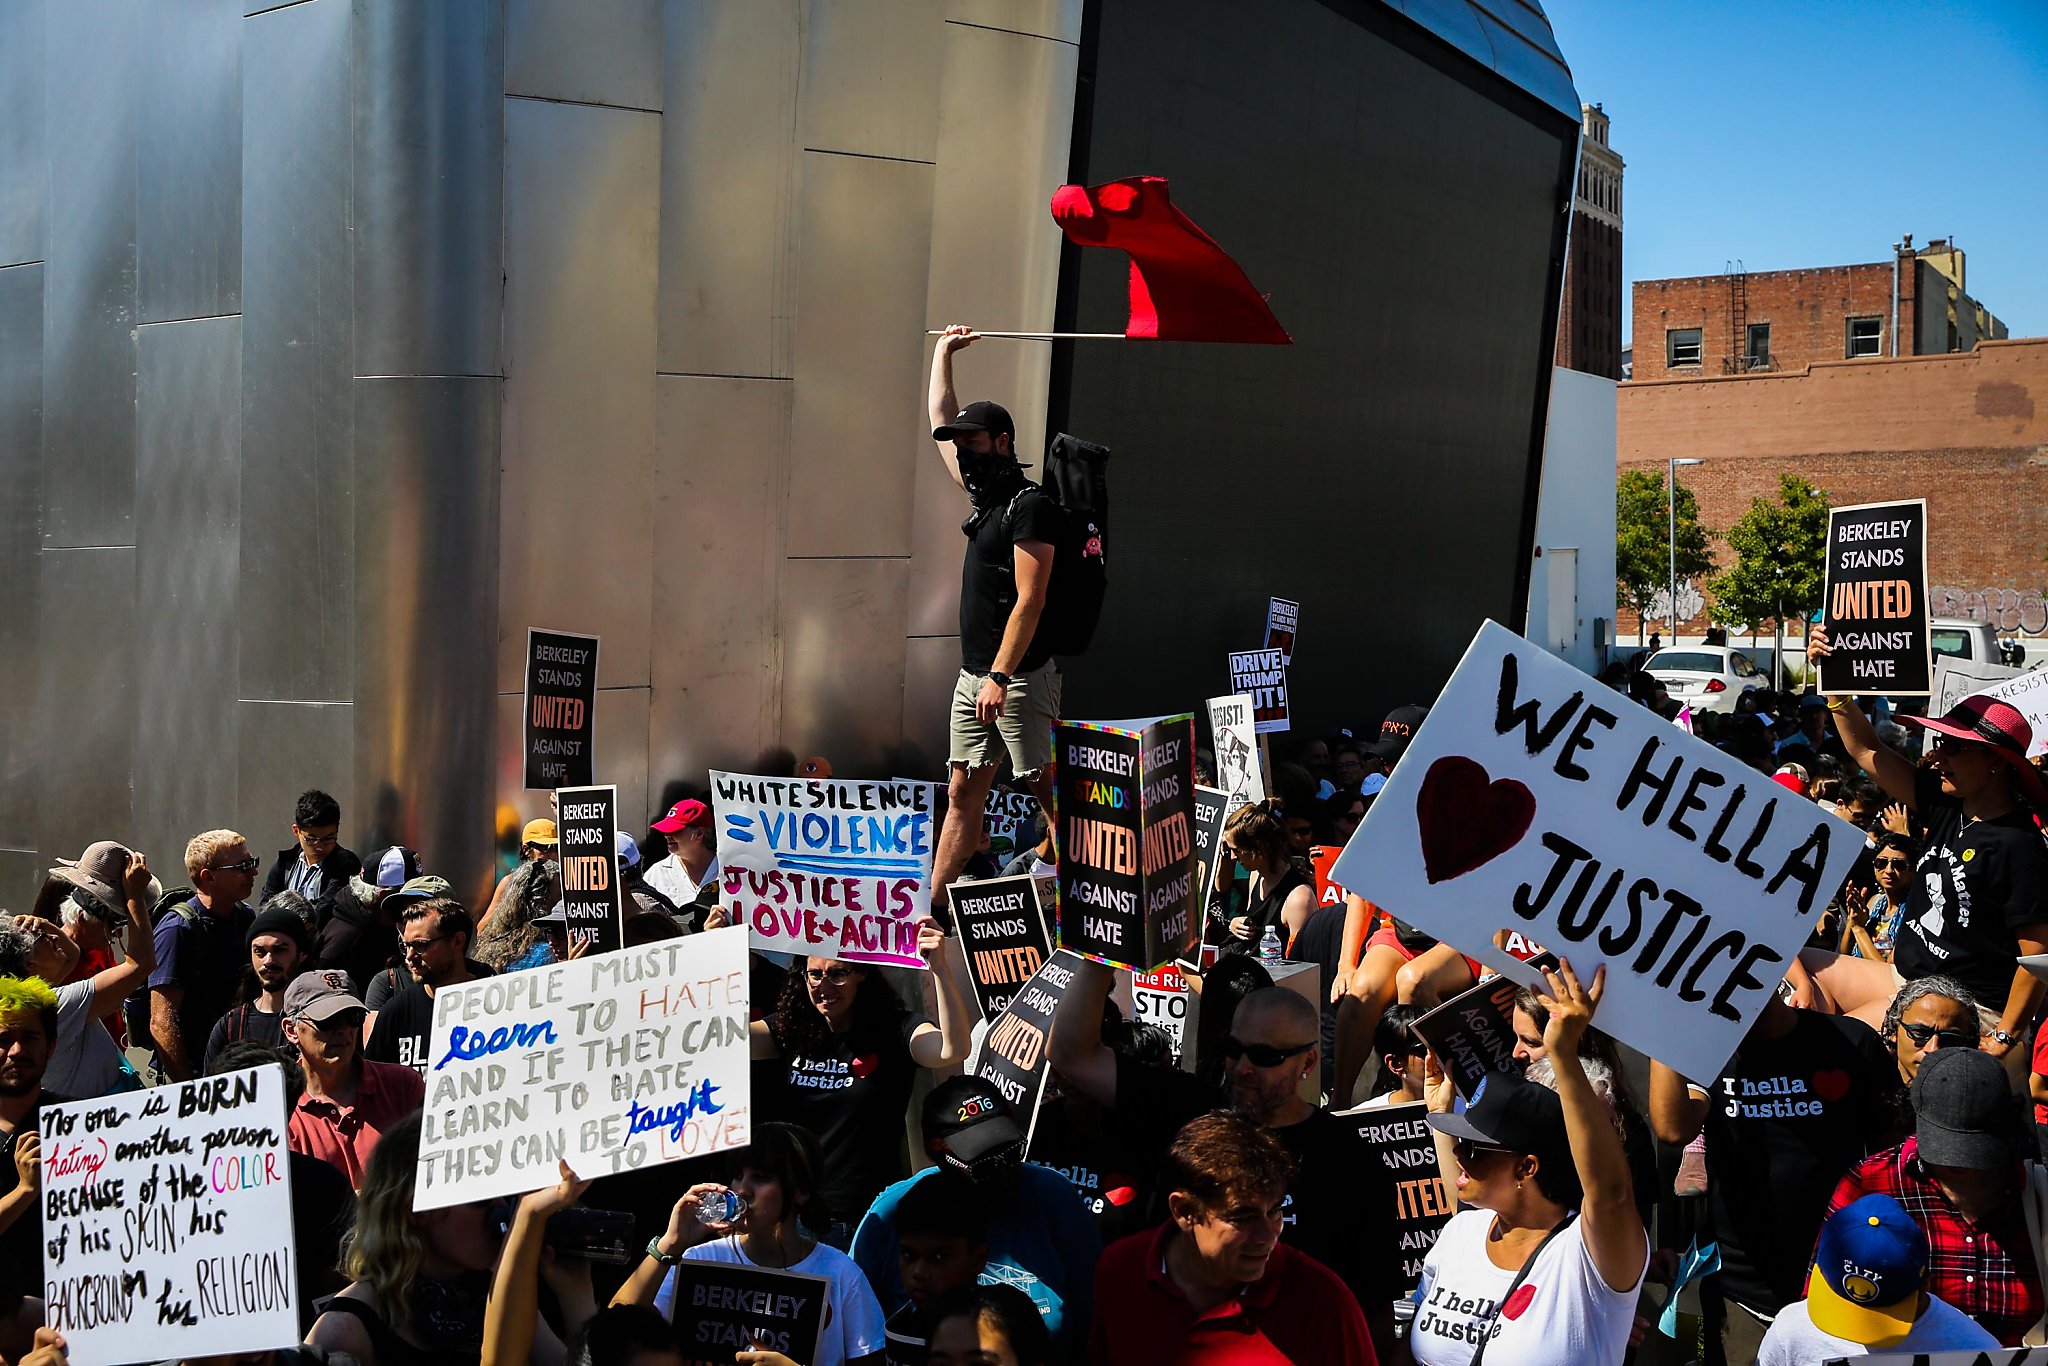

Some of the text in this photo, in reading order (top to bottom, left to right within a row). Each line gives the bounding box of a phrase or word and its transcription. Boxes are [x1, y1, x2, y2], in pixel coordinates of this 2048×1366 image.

[1838, 519, 1912, 543] BERKELEY
[1840, 548, 1904, 570] STANDS
[1272, 601, 1297, 617] BERKELEY
[1831, 580, 1912, 620] UNITED
[536, 645, 589, 665] BERKELEY
[1833, 631, 1913, 650] AGAINST
[538, 669, 582, 687] STANDS
[1232, 652, 1281, 673] DRIVE
[1234, 671, 1282, 688] TRUMP
[1852, 659, 1895, 678] HATE
[533, 694, 584, 730] UNITED
[1236, 687, 1285, 710] UT!
[1213, 704, 1243, 728] RESIST!
[533, 739, 582, 756] AGAINST
[1068, 744, 1135, 778] BERKELEY
[1144, 739, 1181, 776] ERKELEY
[542, 763, 567, 778] HATE
[1495, 653, 1831, 914] WE HELLA
[716, 777, 929, 812] WHITE SILENCE
[1074, 779, 1131, 812] STANDS
[1143, 774, 1179, 810] STANDS
[563, 802, 606, 820] BERKELEY
[565, 828, 602, 844] STANDS
[759, 810, 930, 855] VIOLENCE
[1069, 816, 1137, 876] UNITED
[1144, 811, 1190, 876] UNITED
[564, 856, 609, 891] UNITED
[723, 865, 920, 919] JUSTICE IS
[961, 893, 1025, 916] BERKELEY
[1069, 878, 1138, 915] AGAINST
[1148, 871, 1193, 916] AGAINST
[1950, 864, 1973, 928] Matter
[567, 902, 609, 919] AGAINST
[1161, 909, 1187, 944] HATE
[1512, 832, 1783, 1023] JUSTICE
[971, 918, 1027, 940] STANDS
[1083, 915, 1122, 946] HATE
[973, 945, 1042, 986] UNITED
[1163, 973, 1189, 992] Rig
[438, 943, 683, 1028] PEOPLE MUST
[1023, 986, 1059, 1016] STANDS
[1135, 991, 1187, 1019] STO
[433, 1019, 557, 1071] learn
[568, 998, 617, 1036] TO
[989, 1011, 1044, 1071] UNITED
[432, 1012, 750, 1108] AND IF THEY CAN
[1445, 1031, 1486, 1079] HATE
[790, 1069, 854, 1089] Justice
[979, 1062, 1027, 1105] AGAINST
[1723, 1075, 1808, 1097] I hella
[42, 1071, 257, 1139] No one is BORN
[425, 1093, 529, 1145] LEARN
[543, 1080, 590, 1115] TO
[957, 1097, 994, 1122] 2016
[1725, 1098, 1823, 1118] Justice
[418, 1077, 726, 1189] THEY CAN BE taught
[600, 1106, 748, 1174] TO LOVE
[1358, 1119, 1434, 1144] ERKELEY
[45, 1125, 278, 1189] hating another person
[1382, 1147, 1436, 1170] ANDS
[47, 1152, 281, 1221] BECAUSE of the COLOR
[1045, 1162, 1098, 1188] ella
[1397, 1177, 1452, 1220] ITED
[47, 1222, 70, 1268] of
[80, 1219, 111, 1255] his
[189, 1198, 228, 1236] his
[156, 1277, 198, 1326] his
[197, 1246, 290, 1319] RELIGION
[1844, 1264, 1883, 1281] CITY
[693, 1284, 806, 1319] BERKELEY
[1428, 1287, 1446, 1306] I
[696, 1320, 791, 1353] STANDS
[1420, 1311, 1502, 1345] Justie
